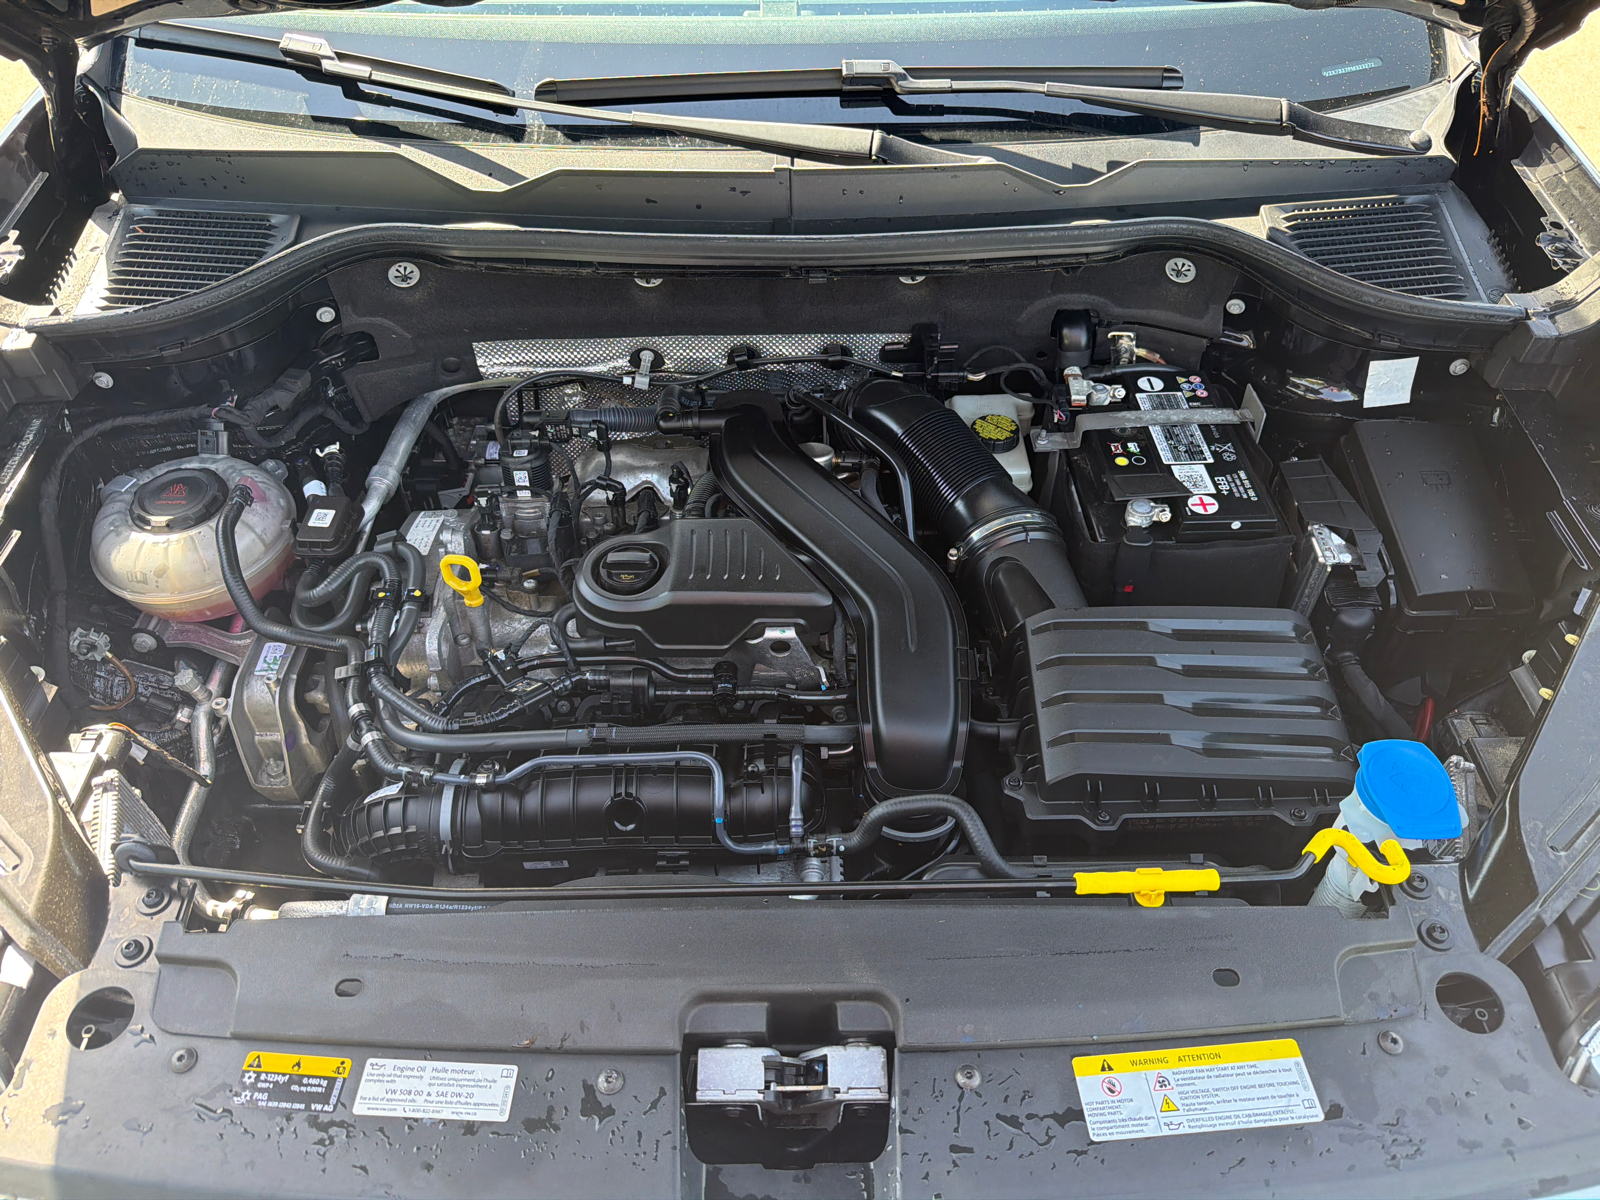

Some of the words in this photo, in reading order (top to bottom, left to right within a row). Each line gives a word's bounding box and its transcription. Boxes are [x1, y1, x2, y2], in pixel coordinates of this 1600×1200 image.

[1214, 476, 1230, 496] EFB+
[1129, 1056, 1169, 1067] WARNING
[1178, 1052, 1222, 1063] ATTENTION
[392, 1064, 415, 1073] Engine
[260, 1073, 289, 1084] R-1234yf
[320, 1078, 328, 1087] kg
